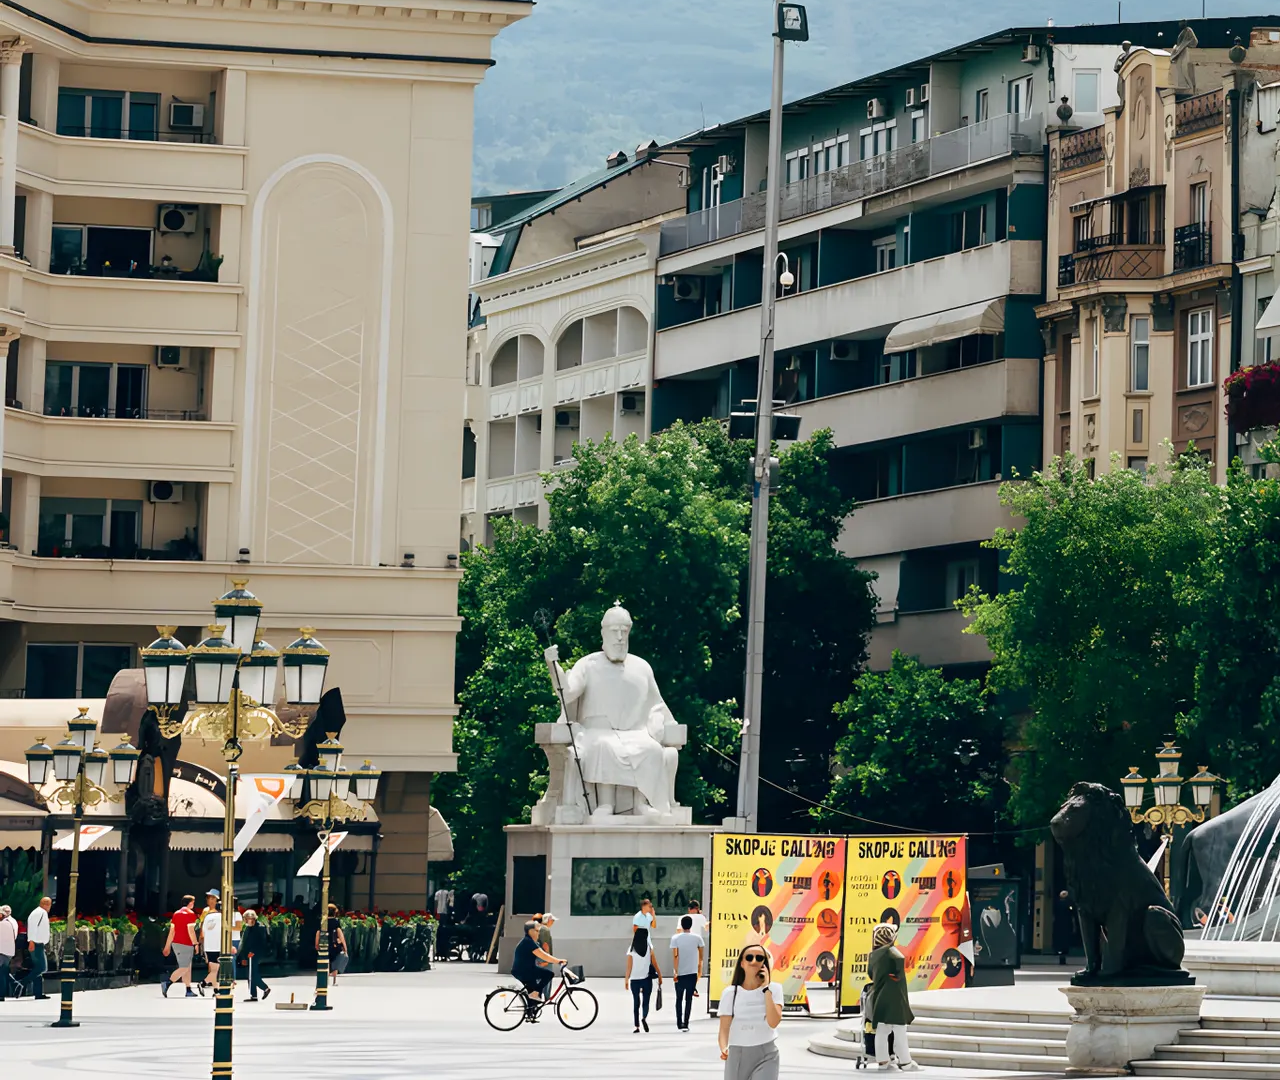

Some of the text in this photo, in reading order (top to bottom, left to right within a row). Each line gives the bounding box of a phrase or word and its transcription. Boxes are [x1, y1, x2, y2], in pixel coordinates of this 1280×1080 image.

[725, 838, 835, 858] SKOPJE CALLING
[858, 839, 957, 859] SKOPJE CALLING
[605, 866, 668, 885] ЦАР
